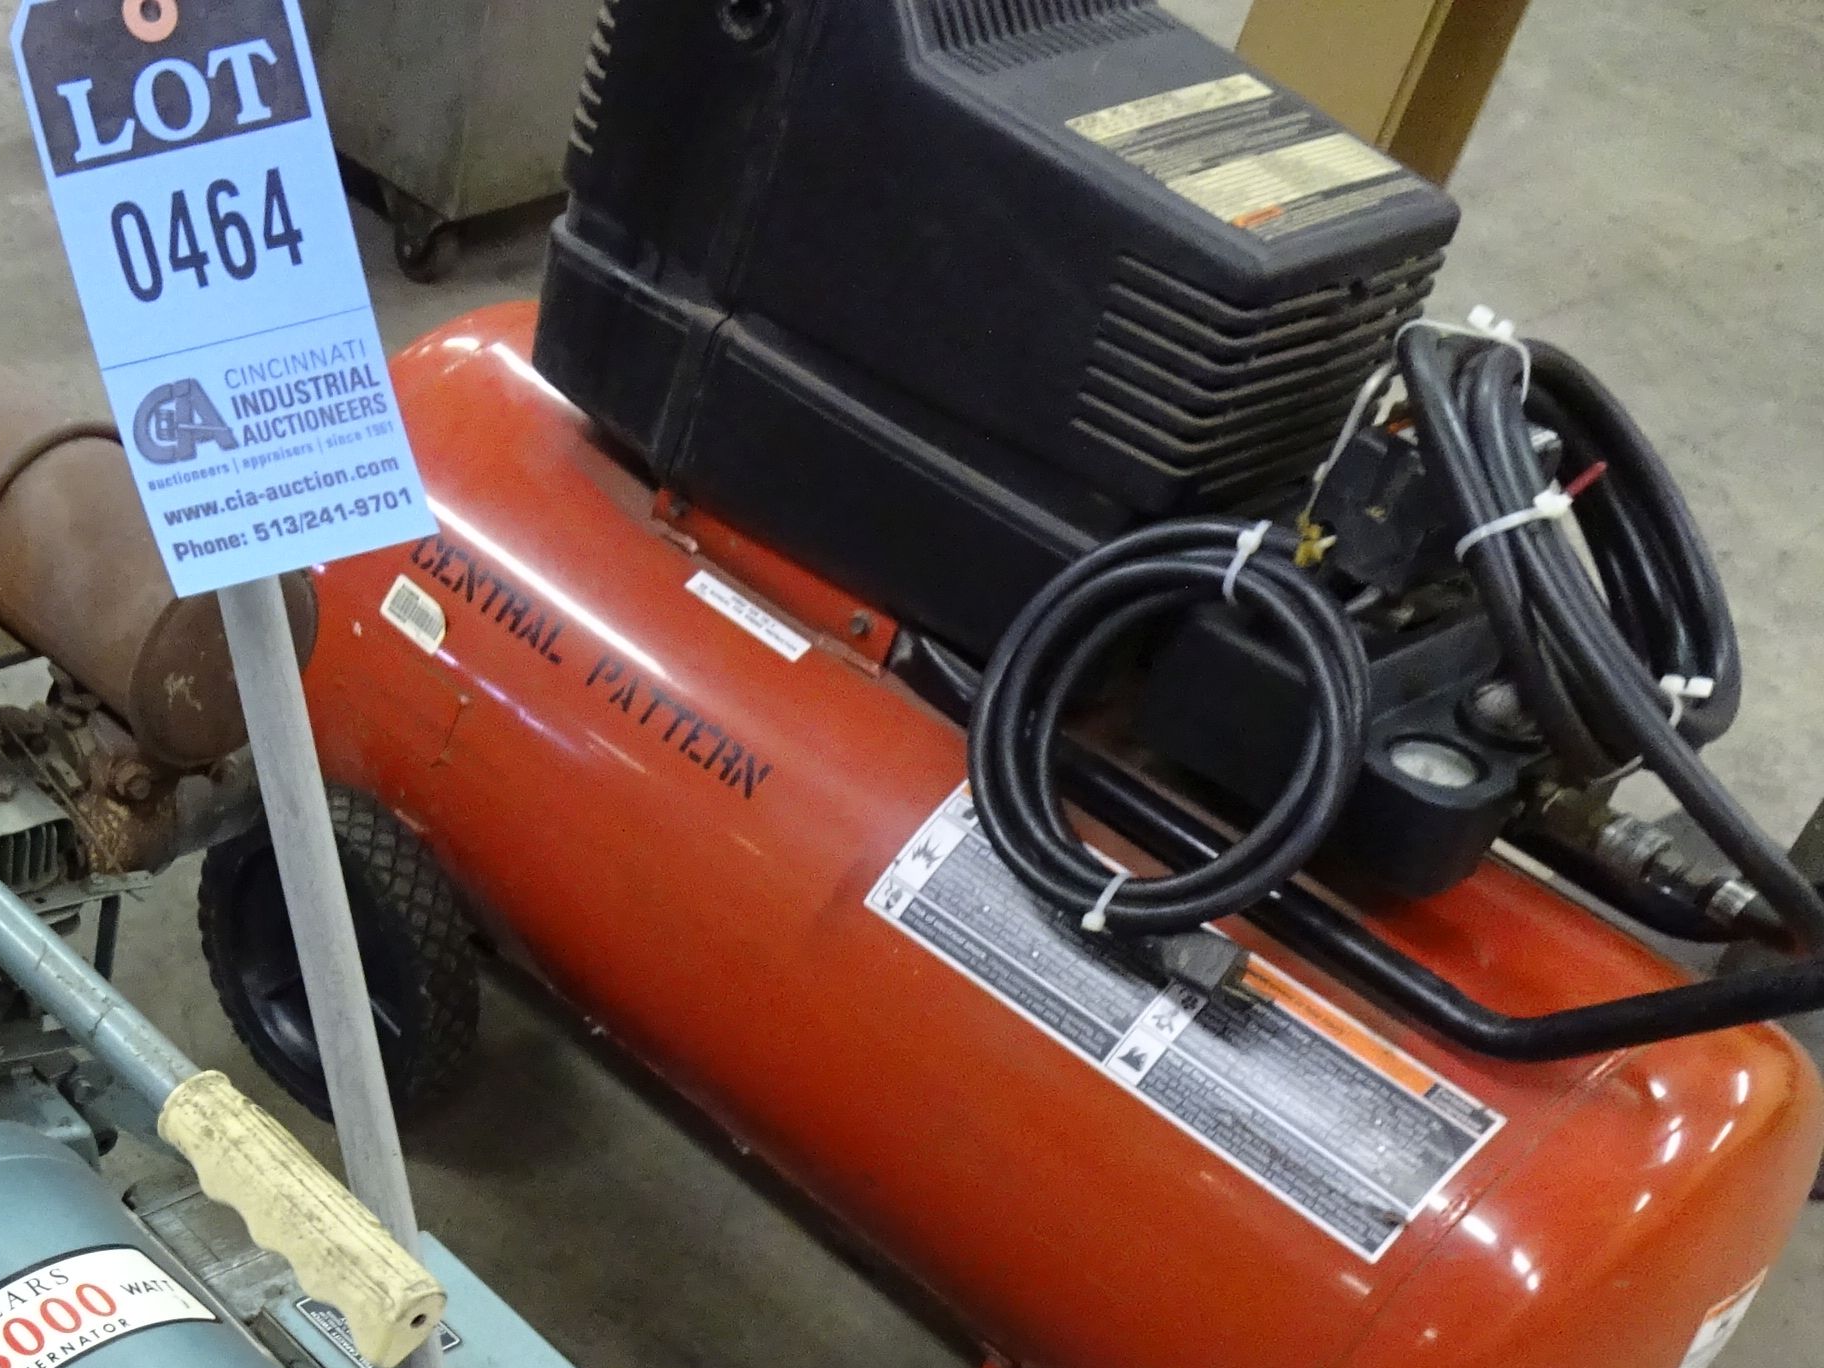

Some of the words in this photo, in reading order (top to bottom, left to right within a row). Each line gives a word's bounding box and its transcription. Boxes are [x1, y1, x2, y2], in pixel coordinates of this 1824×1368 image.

[57, 39, 277, 162] LOT
[110, 167, 303, 302] 0464
[223, 339, 367, 389] CINCINNATI
[230, 363, 381, 420] INDUSTRIAL
[241, 392, 388, 447] AUCTIONEERS
[148, 460, 230, 491] auctioneers
[242, 439, 314, 472] appraisers
[325, 428, 364, 449] since
[163, 454, 400, 527] www.cia-auction.com
[172, 526, 248, 562] Phone:
[253, 487, 414, 544] 513/241-9701
[410, 536, 564, 664] CENTRAL
[585, 653, 774, 801] PATTERN
[119, 1278, 175, 1297] WATT
